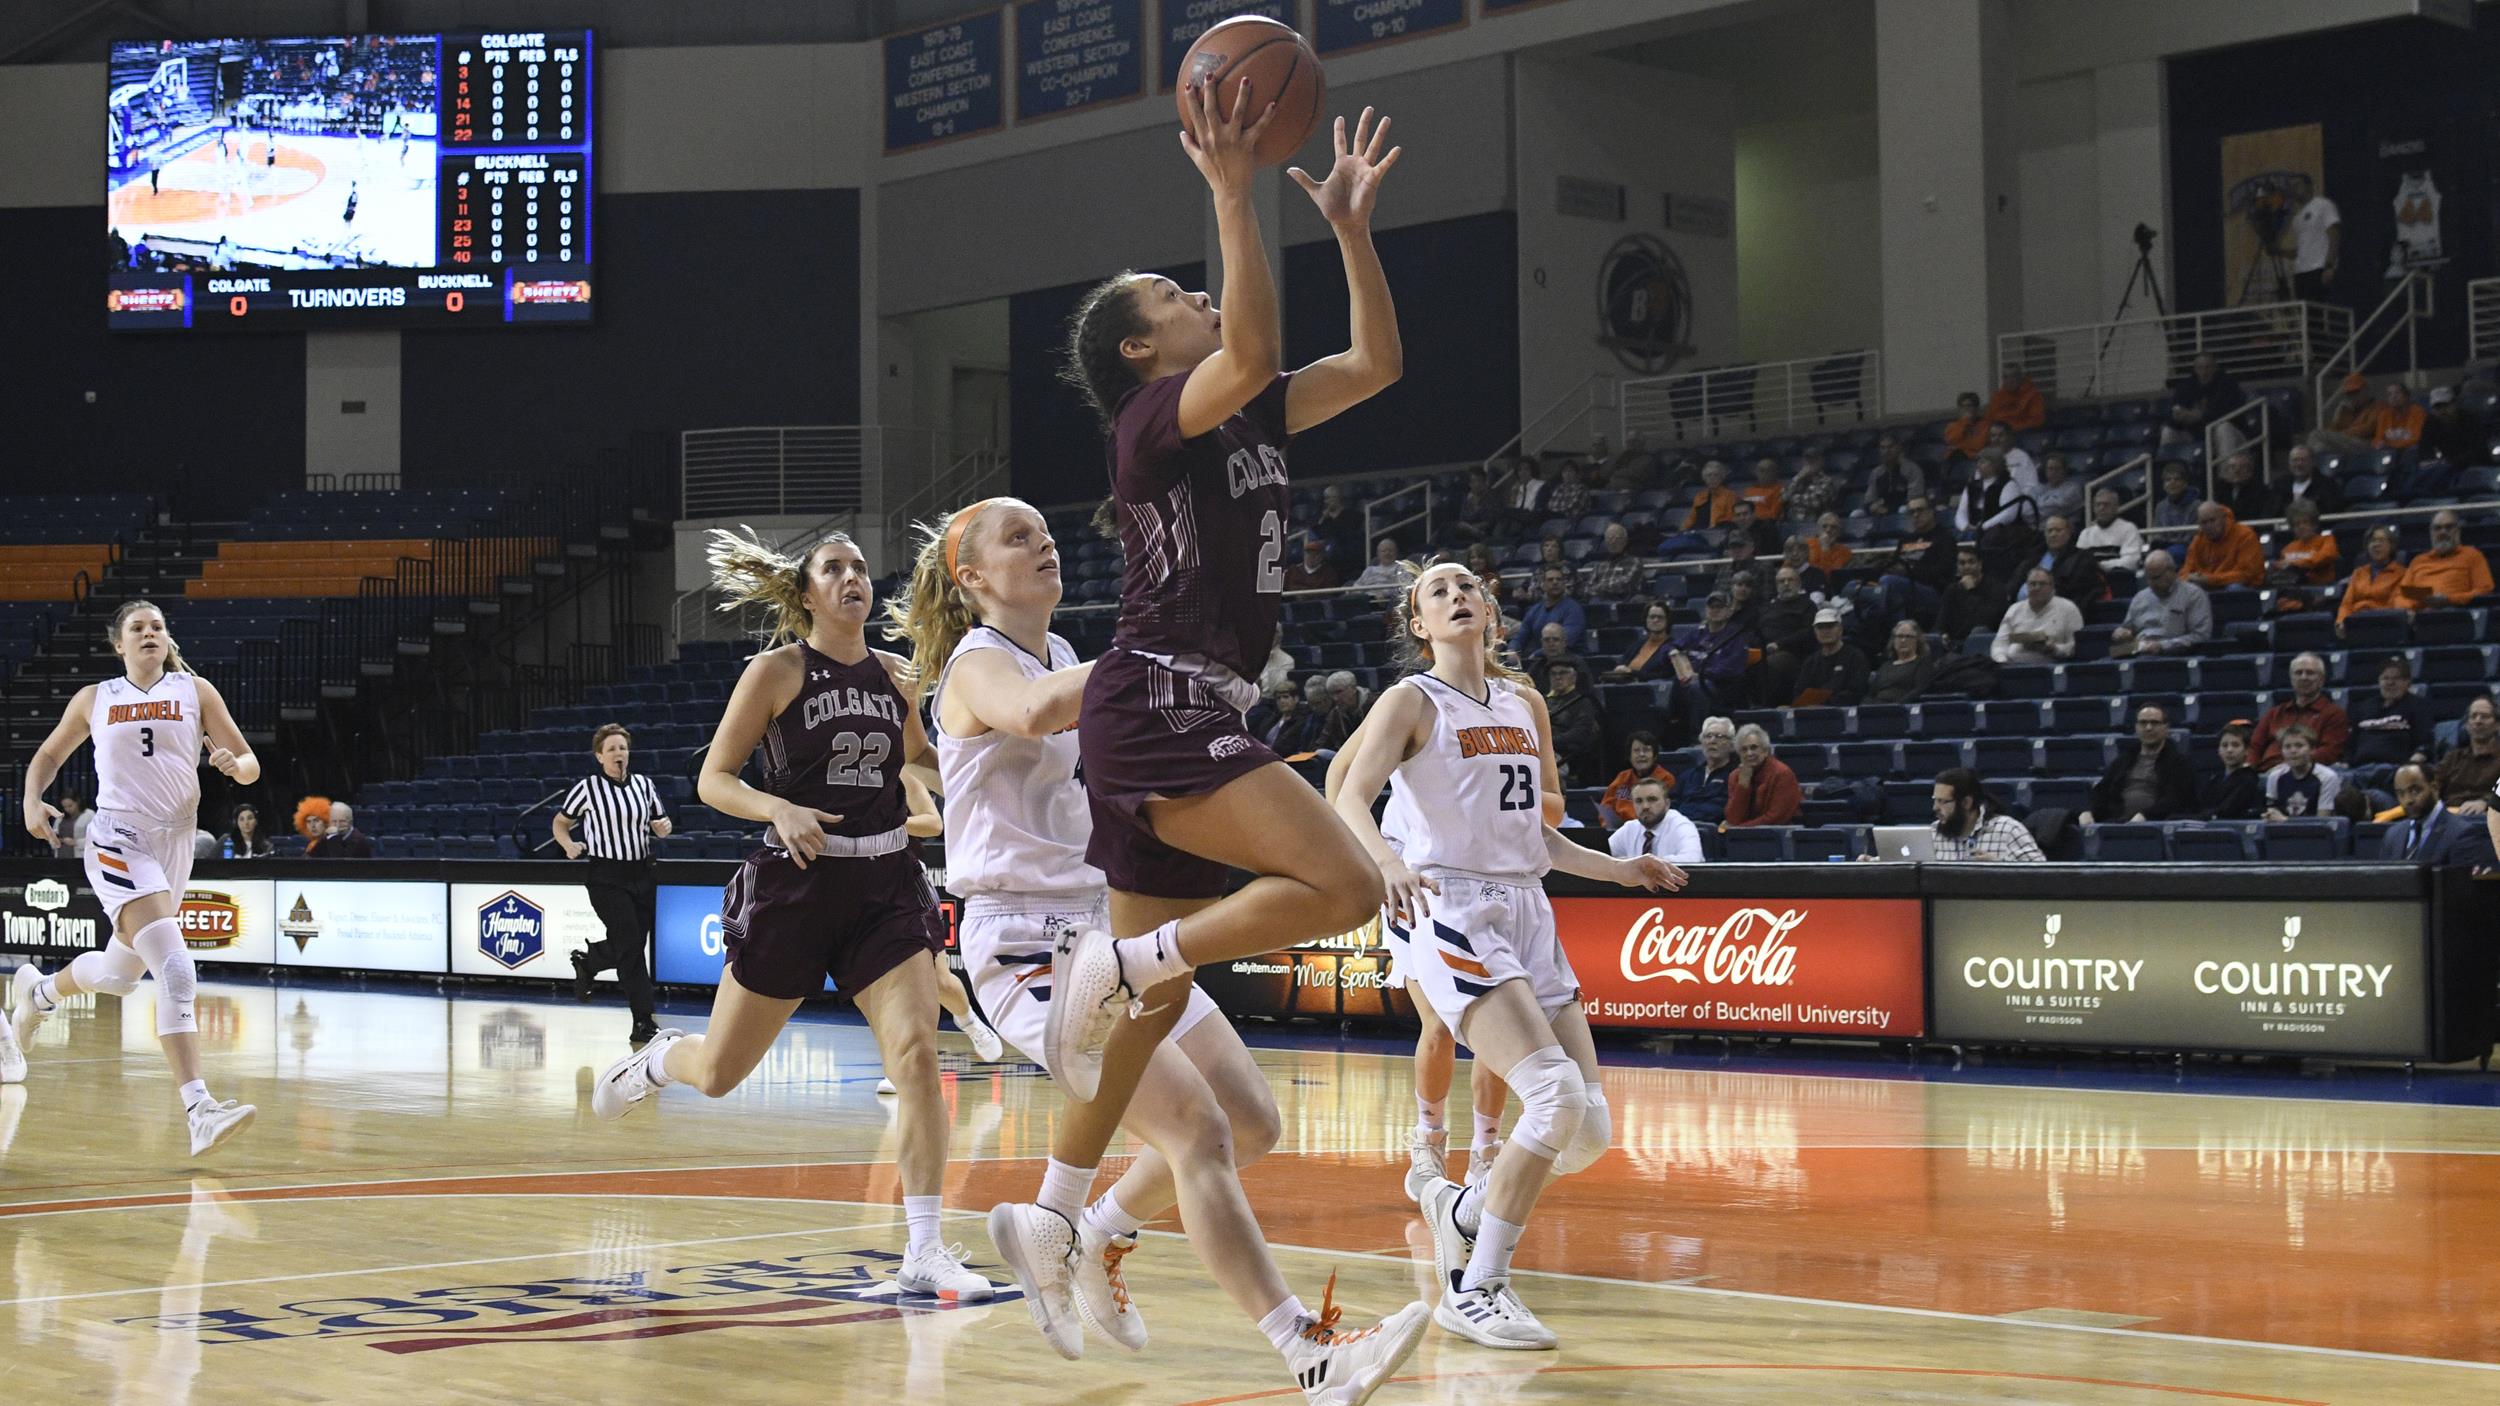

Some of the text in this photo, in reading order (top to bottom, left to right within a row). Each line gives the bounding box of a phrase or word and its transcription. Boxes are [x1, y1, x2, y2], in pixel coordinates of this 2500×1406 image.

[1043, 16, 1071, 35] EAST
[1076, 5, 1112, 28] COAST
[481, 33, 545, 49] COLGATE
[1041, 24, 1115, 55] CONFERENCE
[484, 49, 510, 63] PTS
[554, 48, 578, 62] FLS
[910, 40, 974, 70] EAST COAST
[1026, 41, 1130, 76] WESTERN SECTION
[458, 63, 572, 79] 3 0 0 0
[908, 57, 977, 88] CONFERENCE
[1040, 62, 1118, 92] CO-CHAMPION
[492, 80, 504, 94] 0
[527, 79, 538, 93] 0
[561, 79, 572, 93] 0
[894, 73, 992, 108] WESTERN SECTION
[457, 94, 572, 110] 14 0 0 0
[916, 97, 969, 123] CHAMPION
[456, 110, 572, 126] 21 0 0 0
[454, 126, 572, 141] 22 0 0 0
[474, 154, 549, 170] BUCKNELL
[484, 170, 509, 184] PTS
[553, 169, 578, 182] FLS
[458, 185, 572, 200] 3 0 0 0
[458, 201, 572, 216] 11 0 0 0
[454, 216, 572, 232] 23 0 0 0
[454, 232, 572, 247] 25 0 0 0
[453, 248, 571, 263] 40 0 0 0
[208, 278, 270, 293] COLGATE
[418, 274, 492, 289] BUCKNELL
[120, 294, 174, 305] SHEETZ
[288, 287, 406, 309] TURNOVERS
[523, 287, 579, 297] SHEETZ
[230, 297, 248, 316] 0
[446, 292, 464, 312] 0
[1227, 444, 1289, 499] COLG
[1256, 510, 1288, 593] 2
[108, 700, 183, 725] BUCKNELL
[141, 728, 154, 756] 3
[1457, 726, 1540, 759] BUCKNEL
[827, 732, 891, 788] 22
[1500, 764, 1534, 811] 23
[2, 910, 96, 948] Towne Tavern
[482, 910, 540, 938] Hampton
[700, 913, 727, 956] G
[496, 933, 524, 959] Inn
[1620, 906, 1808, 986] Coca-Cola
[1232, 962, 1290, 974] dailyitem.com
[1294, 962, 1384, 997] More Sports
[2006, 995, 2100, 1009] INN & SUITES
[2241, 1001, 2345, 1015] INN & SUITES
[1604, 1000, 1686, 1019] supporter
[1693, 1001, 1711, 1019] of
[1716, 1002, 1792, 1022] Bucknell
[1798, 1004, 1890, 1028] University
[2026, 1016, 2083, 1025] BY RADISSON
[2263, 1022, 2325, 1033] BY RADISSON
